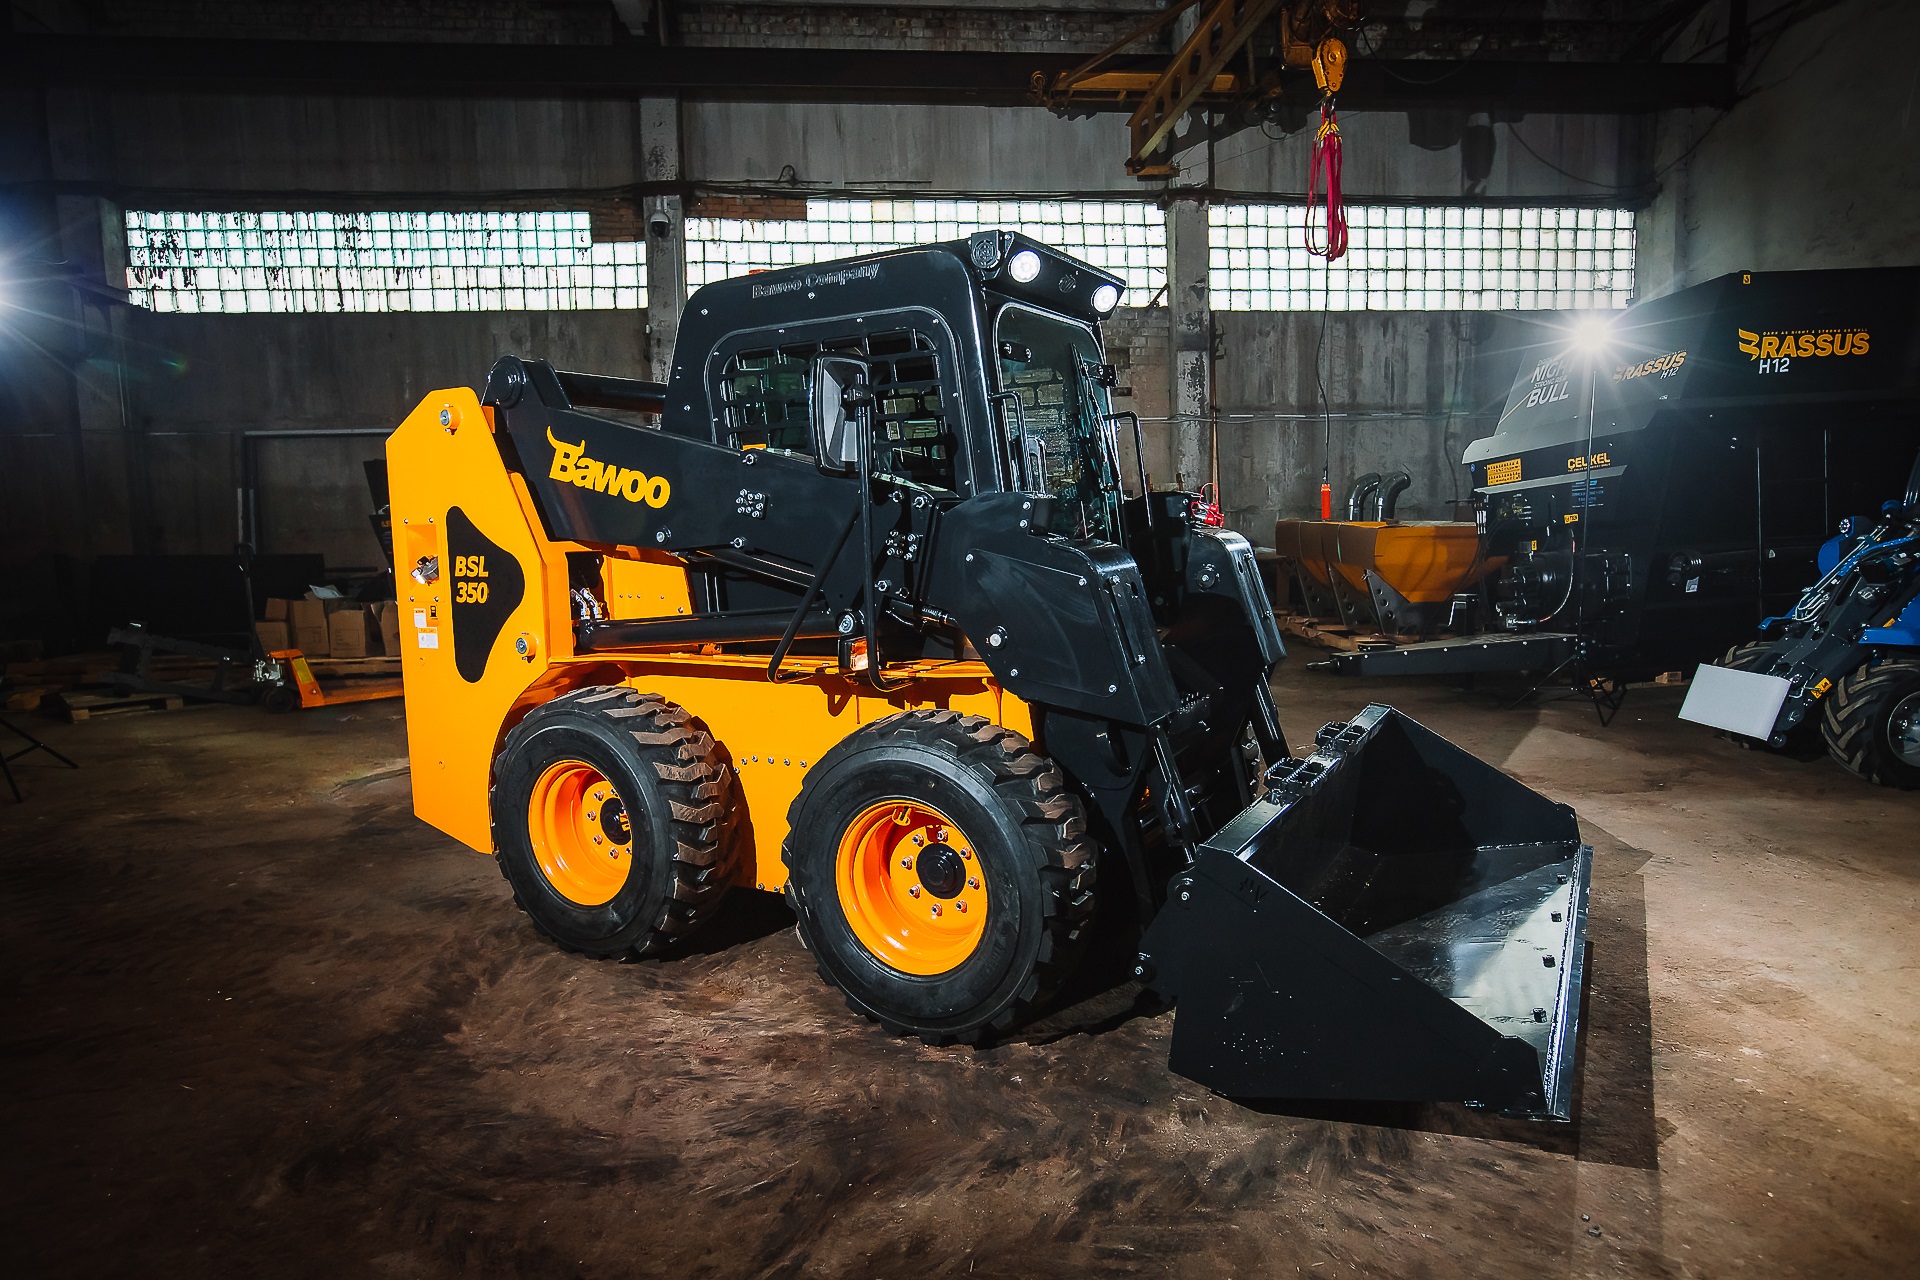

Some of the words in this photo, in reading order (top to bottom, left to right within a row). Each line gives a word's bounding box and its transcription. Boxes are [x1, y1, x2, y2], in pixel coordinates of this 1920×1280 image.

[752, 279, 802, 299] Bawoo
[805, 263, 881, 286] Company
[1660, 367, 1680, 380] H12
[1758, 358, 1790, 374] H12
[1527, 380, 1569, 408] BULL
[546, 426, 671, 509] Bawoo
[1567, 452, 1611, 470] ÇELKEL
[455, 556, 489, 578] BSL
[456, 582, 489, 604] 350
